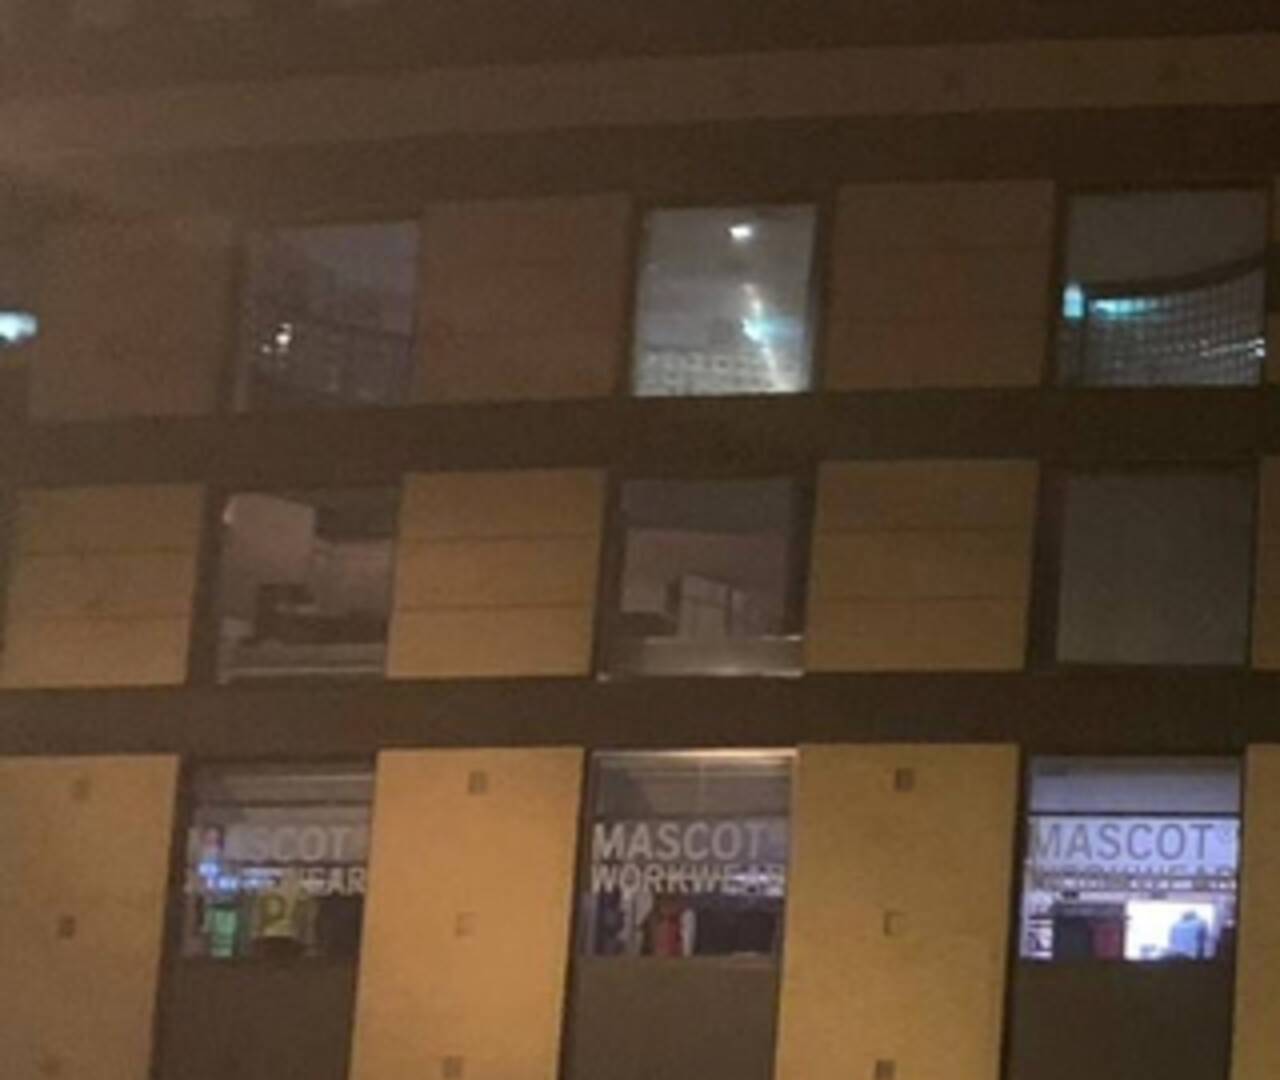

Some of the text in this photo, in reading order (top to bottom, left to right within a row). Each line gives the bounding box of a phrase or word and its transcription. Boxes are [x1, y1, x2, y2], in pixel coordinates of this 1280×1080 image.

[187, 825, 352, 863] SCOT
[592, 822, 768, 861] MASCOT
[1032, 823, 1216, 861] MASCOT
[591, 863, 785, 896] WORKWEAR
